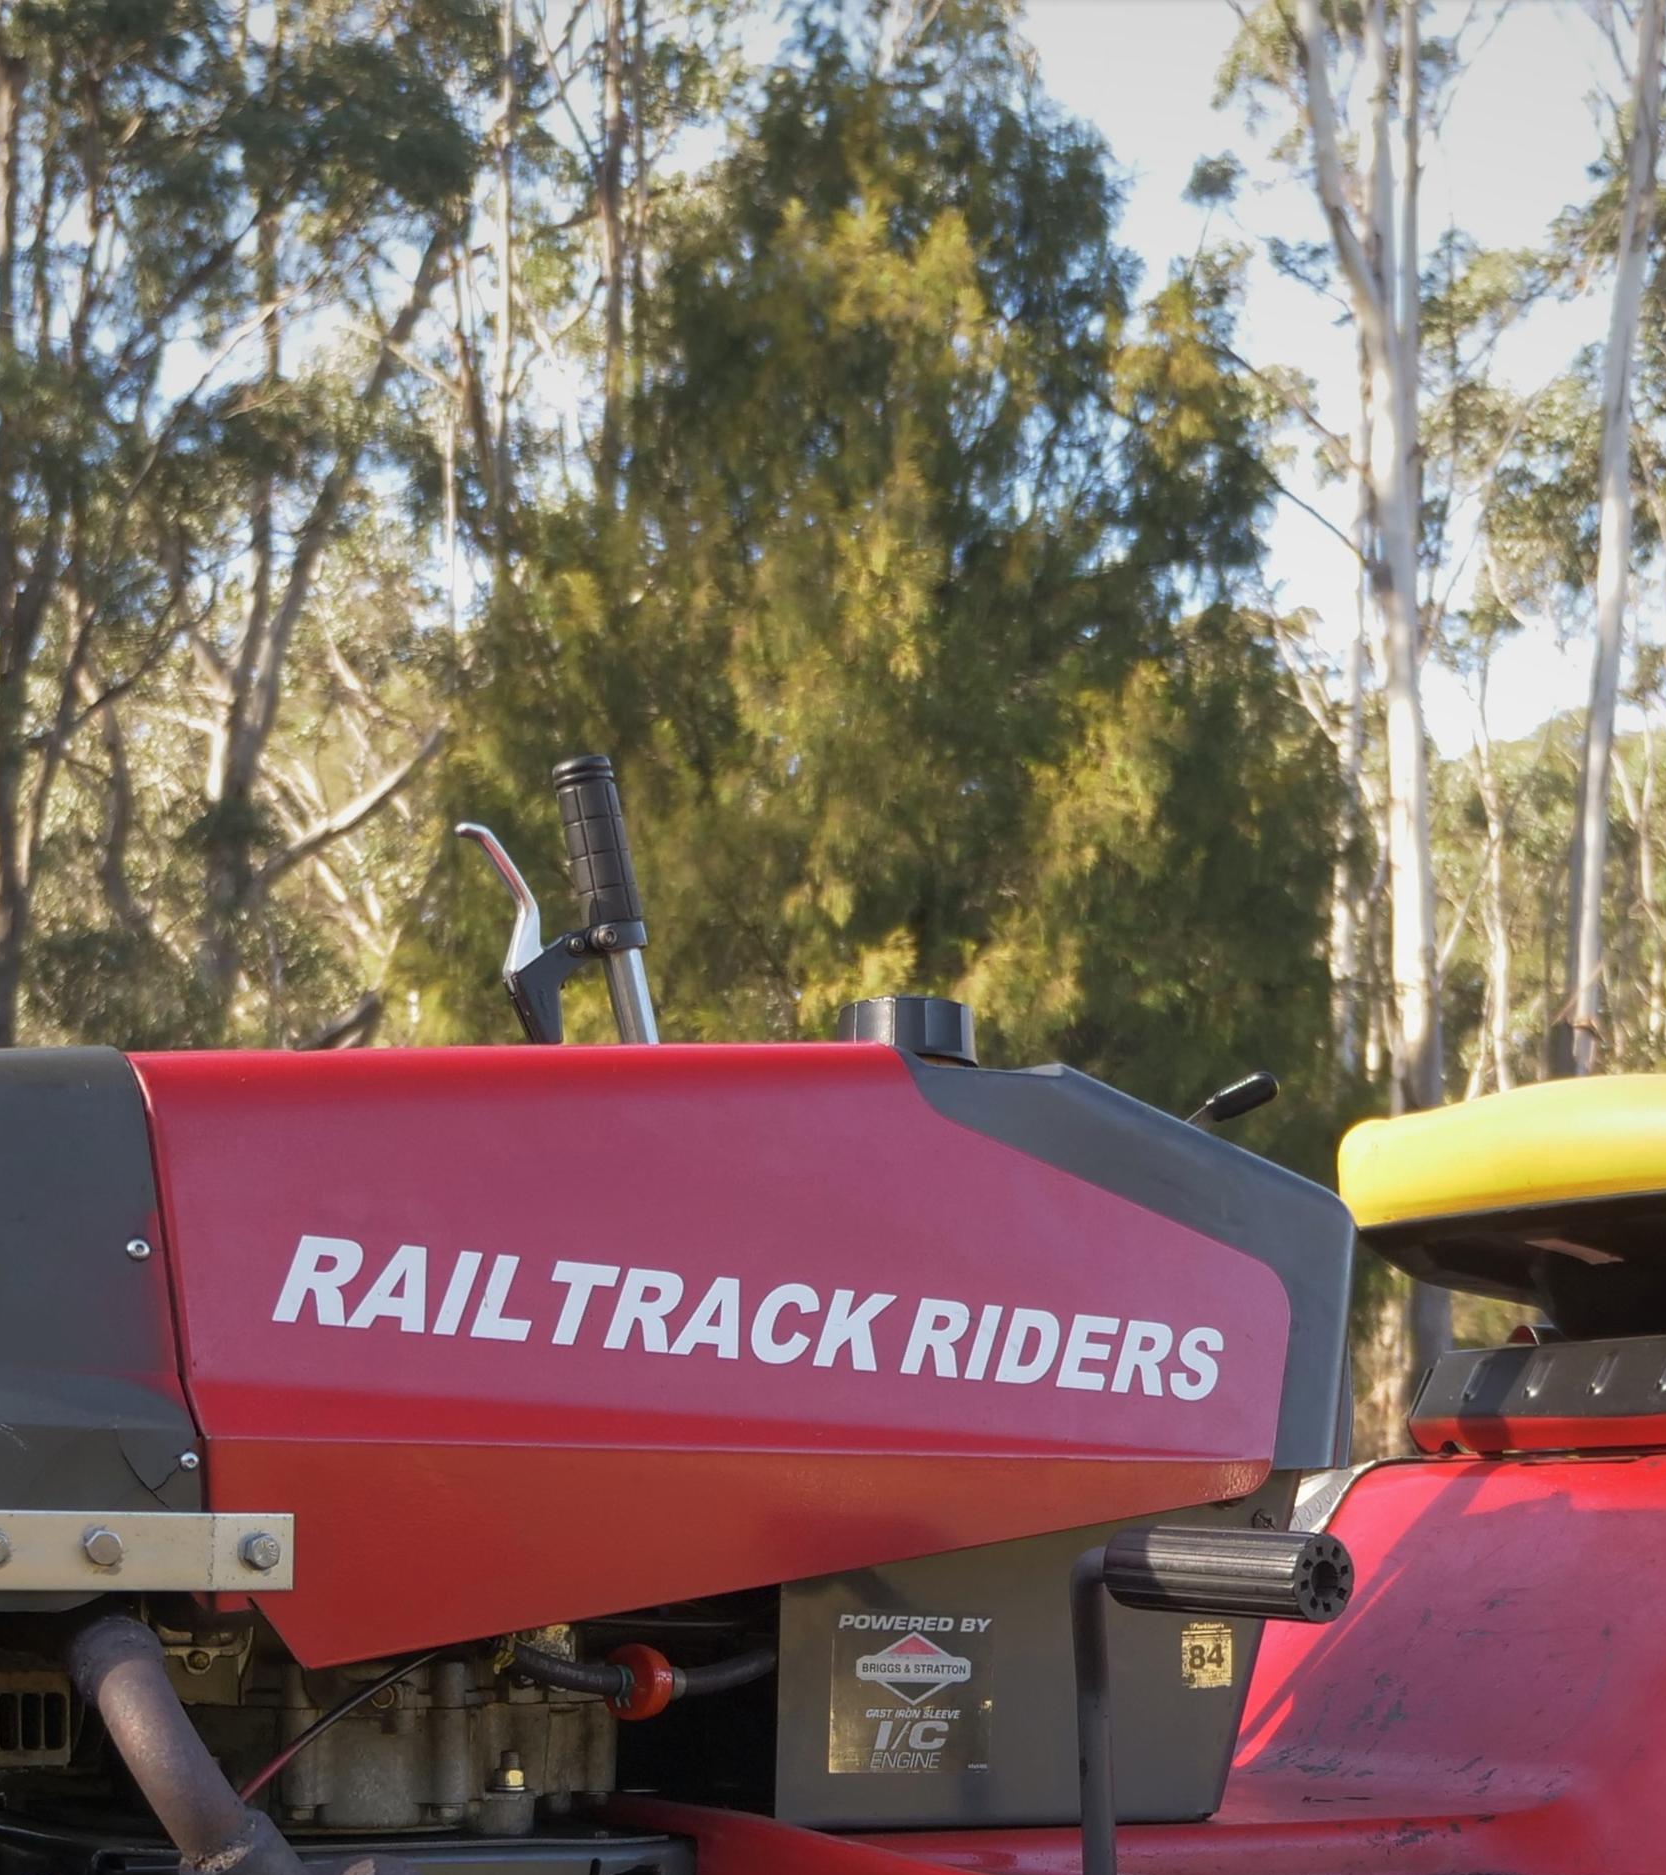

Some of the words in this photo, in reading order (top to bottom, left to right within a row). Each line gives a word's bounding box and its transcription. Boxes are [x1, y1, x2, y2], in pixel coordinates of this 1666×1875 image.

[272, 1235, 532, 1342] RAIL
[552, 1261, 897, 1372] TRACK
[900, 1299, 1225, 1400] RIDERS
[838, 1614, 954, 1632] POWERED
[960, 1617, 992, 1632] BY
[1189, 1643, 1225, 1670] 84
[862, 1662, 901, 1673] BRIGGS
[904, 1663, 911, 1673] &
[914, 1663, 966, 1675] STRATTON
[895, 1708, 921, 1718] IRON
[923, 1708, 961, 1719] SLEEVE
[870, 1752, 941, 1769] ENGINE
